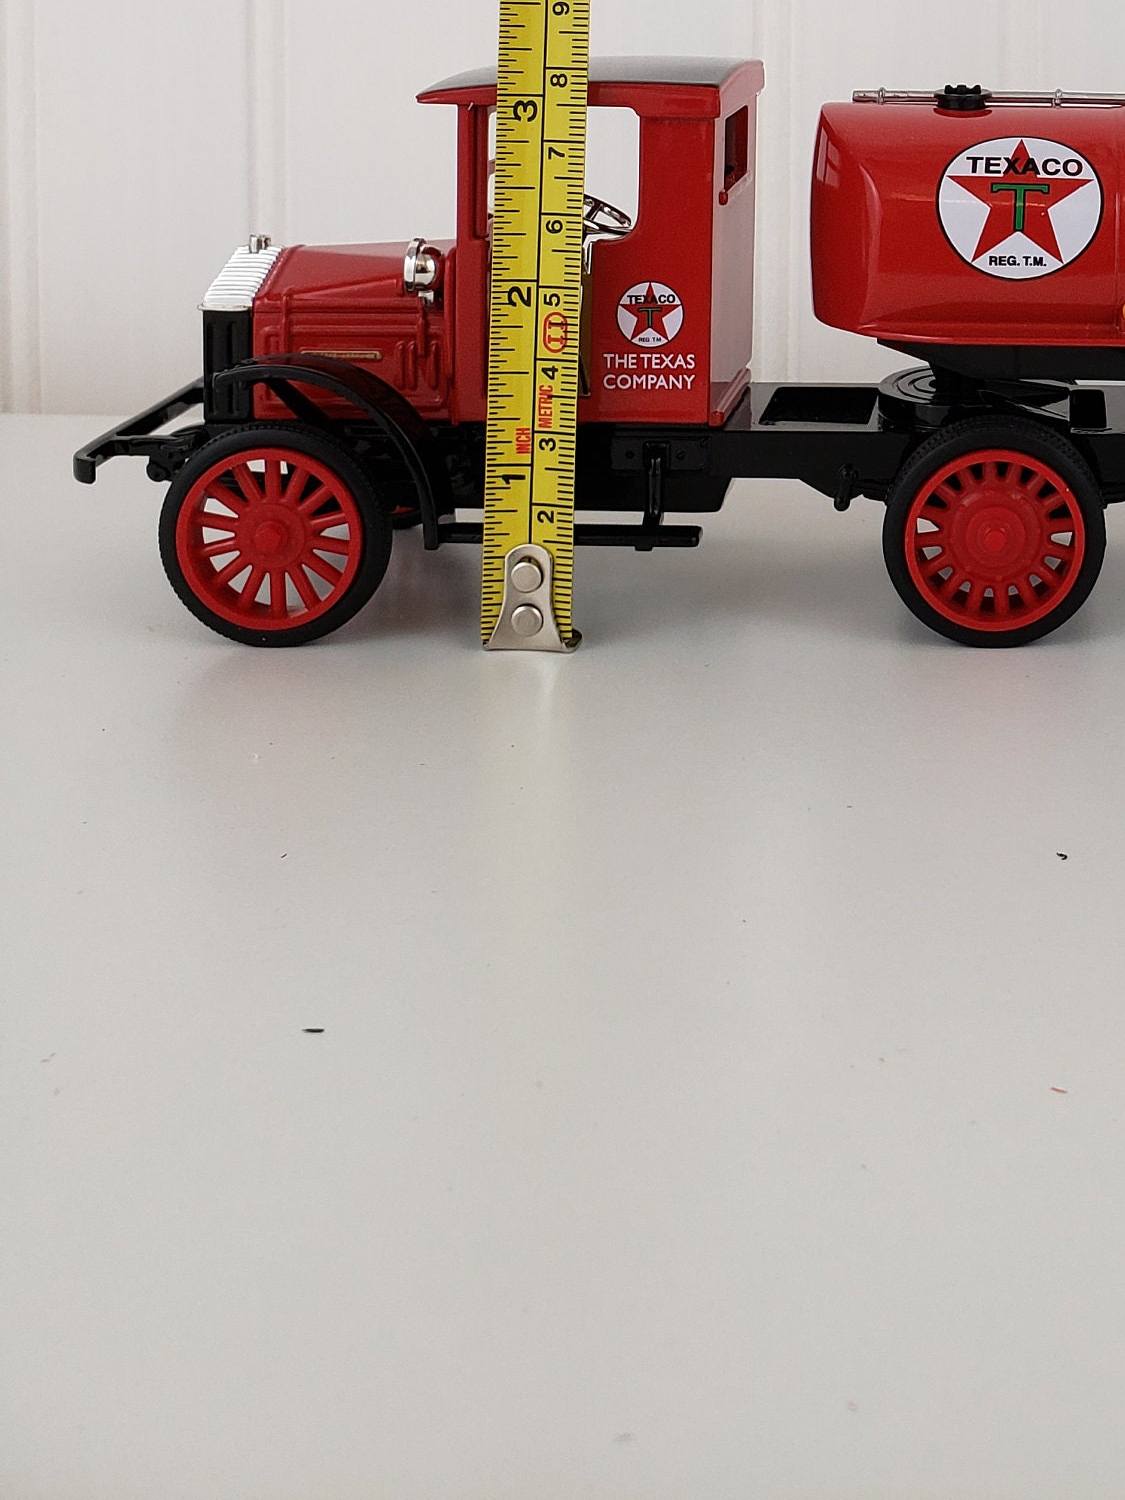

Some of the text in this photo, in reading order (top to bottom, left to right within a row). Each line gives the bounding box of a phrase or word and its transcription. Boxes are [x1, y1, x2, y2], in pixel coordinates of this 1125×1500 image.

[553, 2, 570, 15] 9
[550, 74, 567, 87] 8
[513, 100, 537, 122] 3
[548, 146, 565, 159] 7
[966, 157, 1083, 176] TEXACO
[991, 183, 1049, 232] T
[546, 220, 563, 234] 6
[989, 256, 1047, 267] REG. T.M.
[508, 286, 531, 307] 2
[544, 293, 561, 307] 5
[638, 307, 662, 328] T
[603, 354, 695, 369] THE TEXAS
[542, 365, 559, 380] 4
[603, 374, 695, 390] COMPANY
[538, 385, 553, 428] METRIC
[515, 427, 530, 454] INCH
[539, 438, 556, 451] 3
[502, 474, 526, 485] 1
[537, 510, 554, 523] 2
